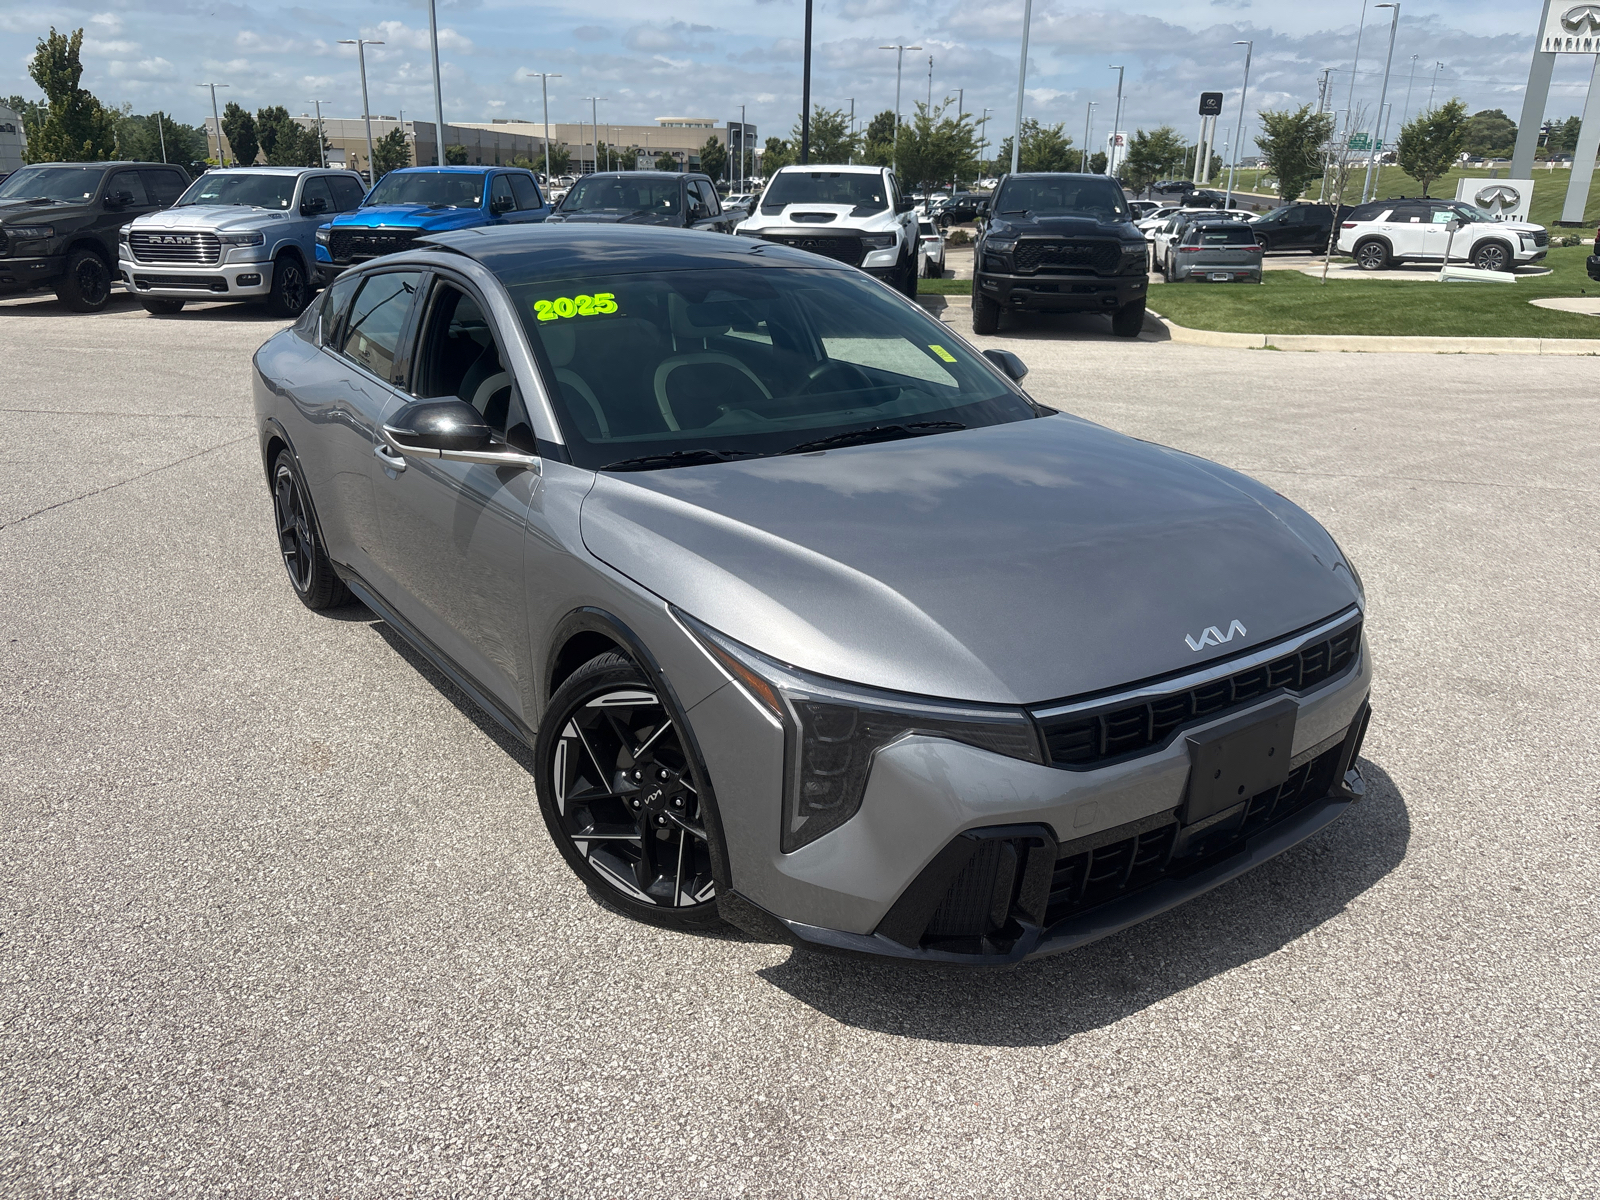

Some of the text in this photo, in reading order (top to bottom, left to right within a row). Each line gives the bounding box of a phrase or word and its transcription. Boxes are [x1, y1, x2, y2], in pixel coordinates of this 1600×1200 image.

[148, 236, 191, 244] RAM
[783, 239, 838, 247] RAM
[533, 292, 618, 321] 2025
[1184, 619, 1247, 652] KIA
